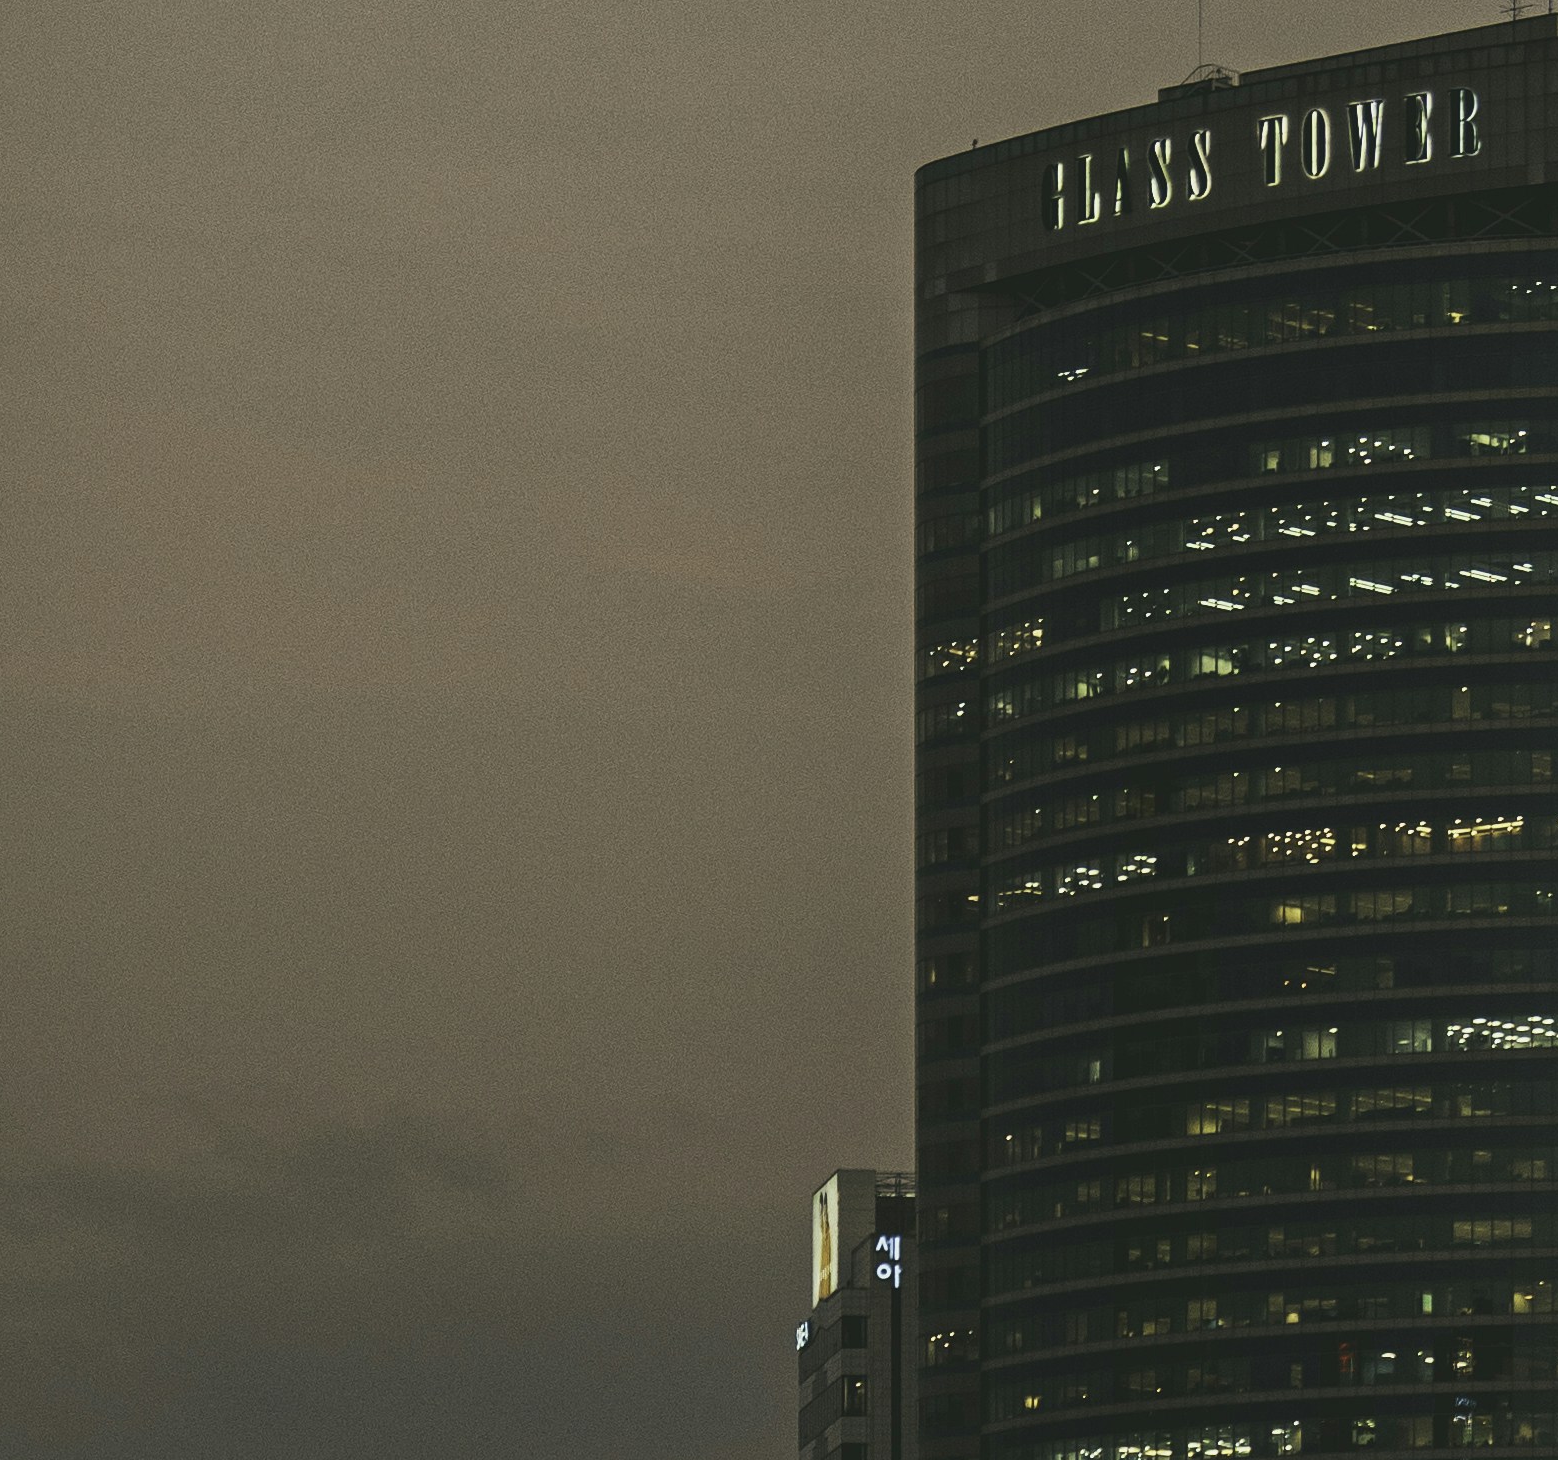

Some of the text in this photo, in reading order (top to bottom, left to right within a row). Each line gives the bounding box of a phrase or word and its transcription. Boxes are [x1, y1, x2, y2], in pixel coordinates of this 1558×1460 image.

[1043, 86, 1482, 230] GLASS TOWER
[875, 1235, 902, 1289] 세아
